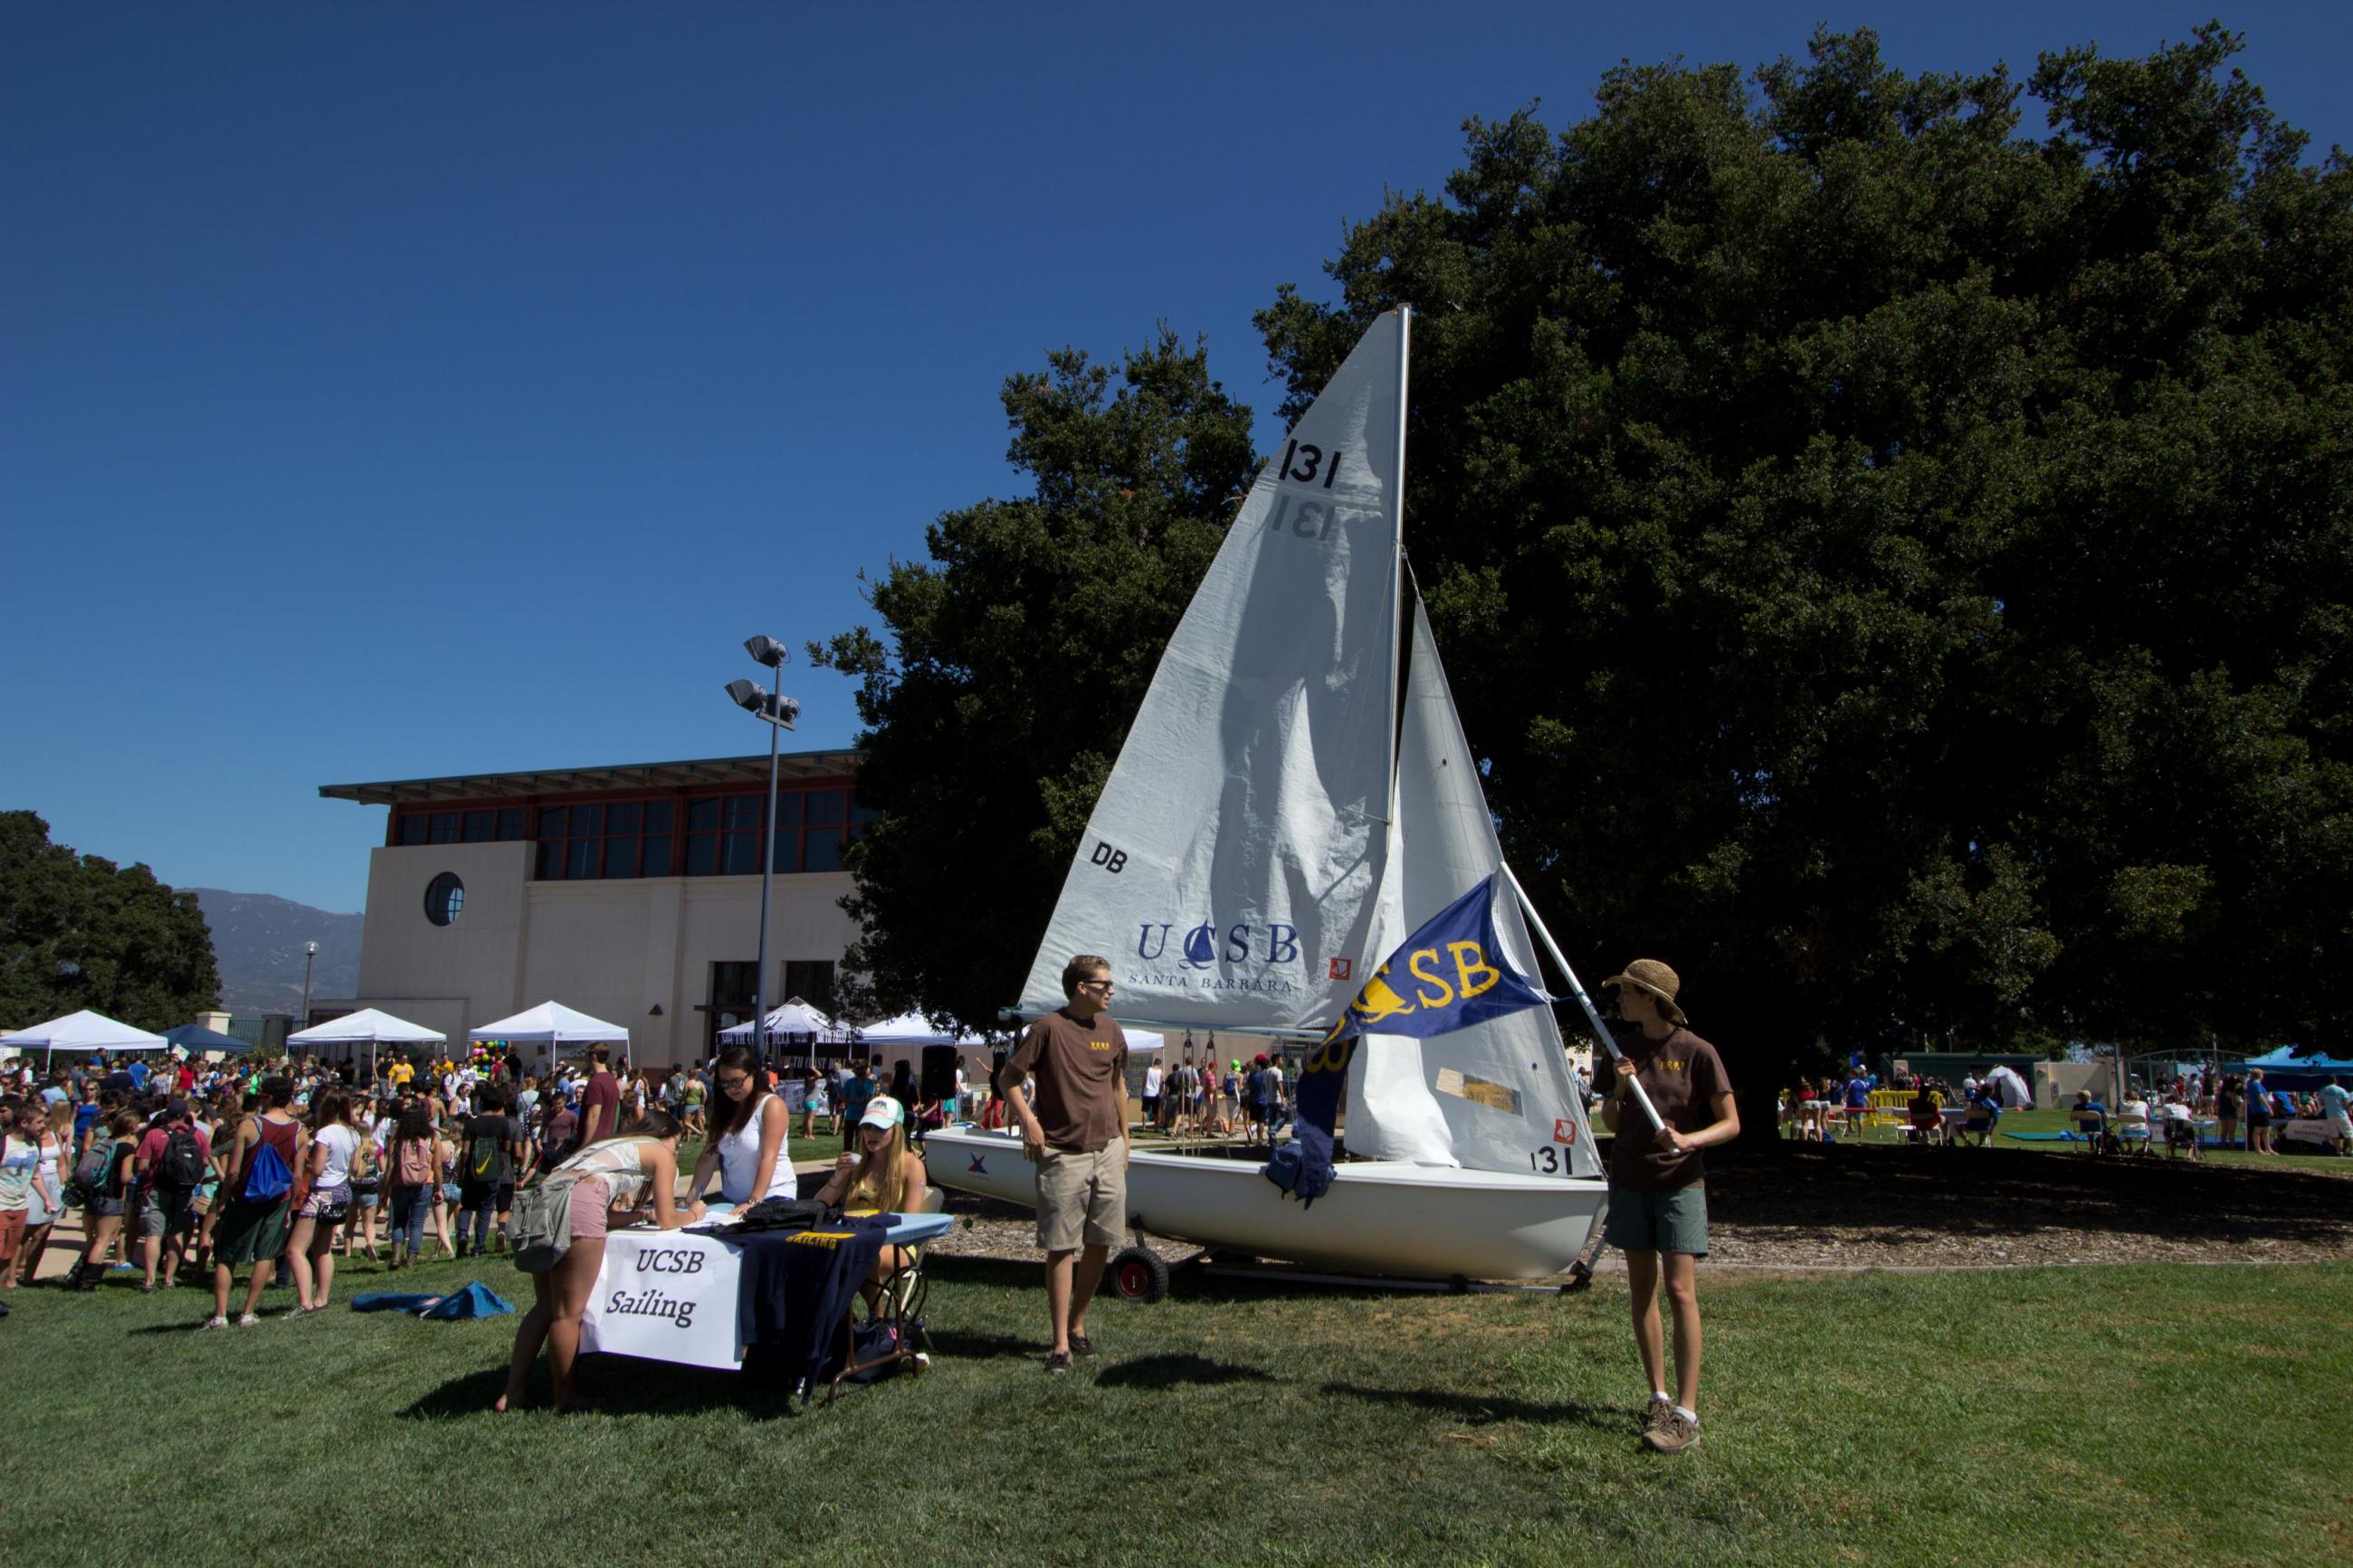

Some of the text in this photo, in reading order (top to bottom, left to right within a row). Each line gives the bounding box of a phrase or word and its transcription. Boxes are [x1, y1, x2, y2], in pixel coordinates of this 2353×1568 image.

[1279, 439, 1341, 489] 131
[1091, 841, 1128, 874] DB
[1138, 920, 1298, 966] UCSB
[1129, 973, 1292, 993] SANTA BARBARA
[1530, 1145, 1573, 1175] 131
[636, 1249, 705, 1274] UCSB
[606, 1289, 697, 1328] Sailing
